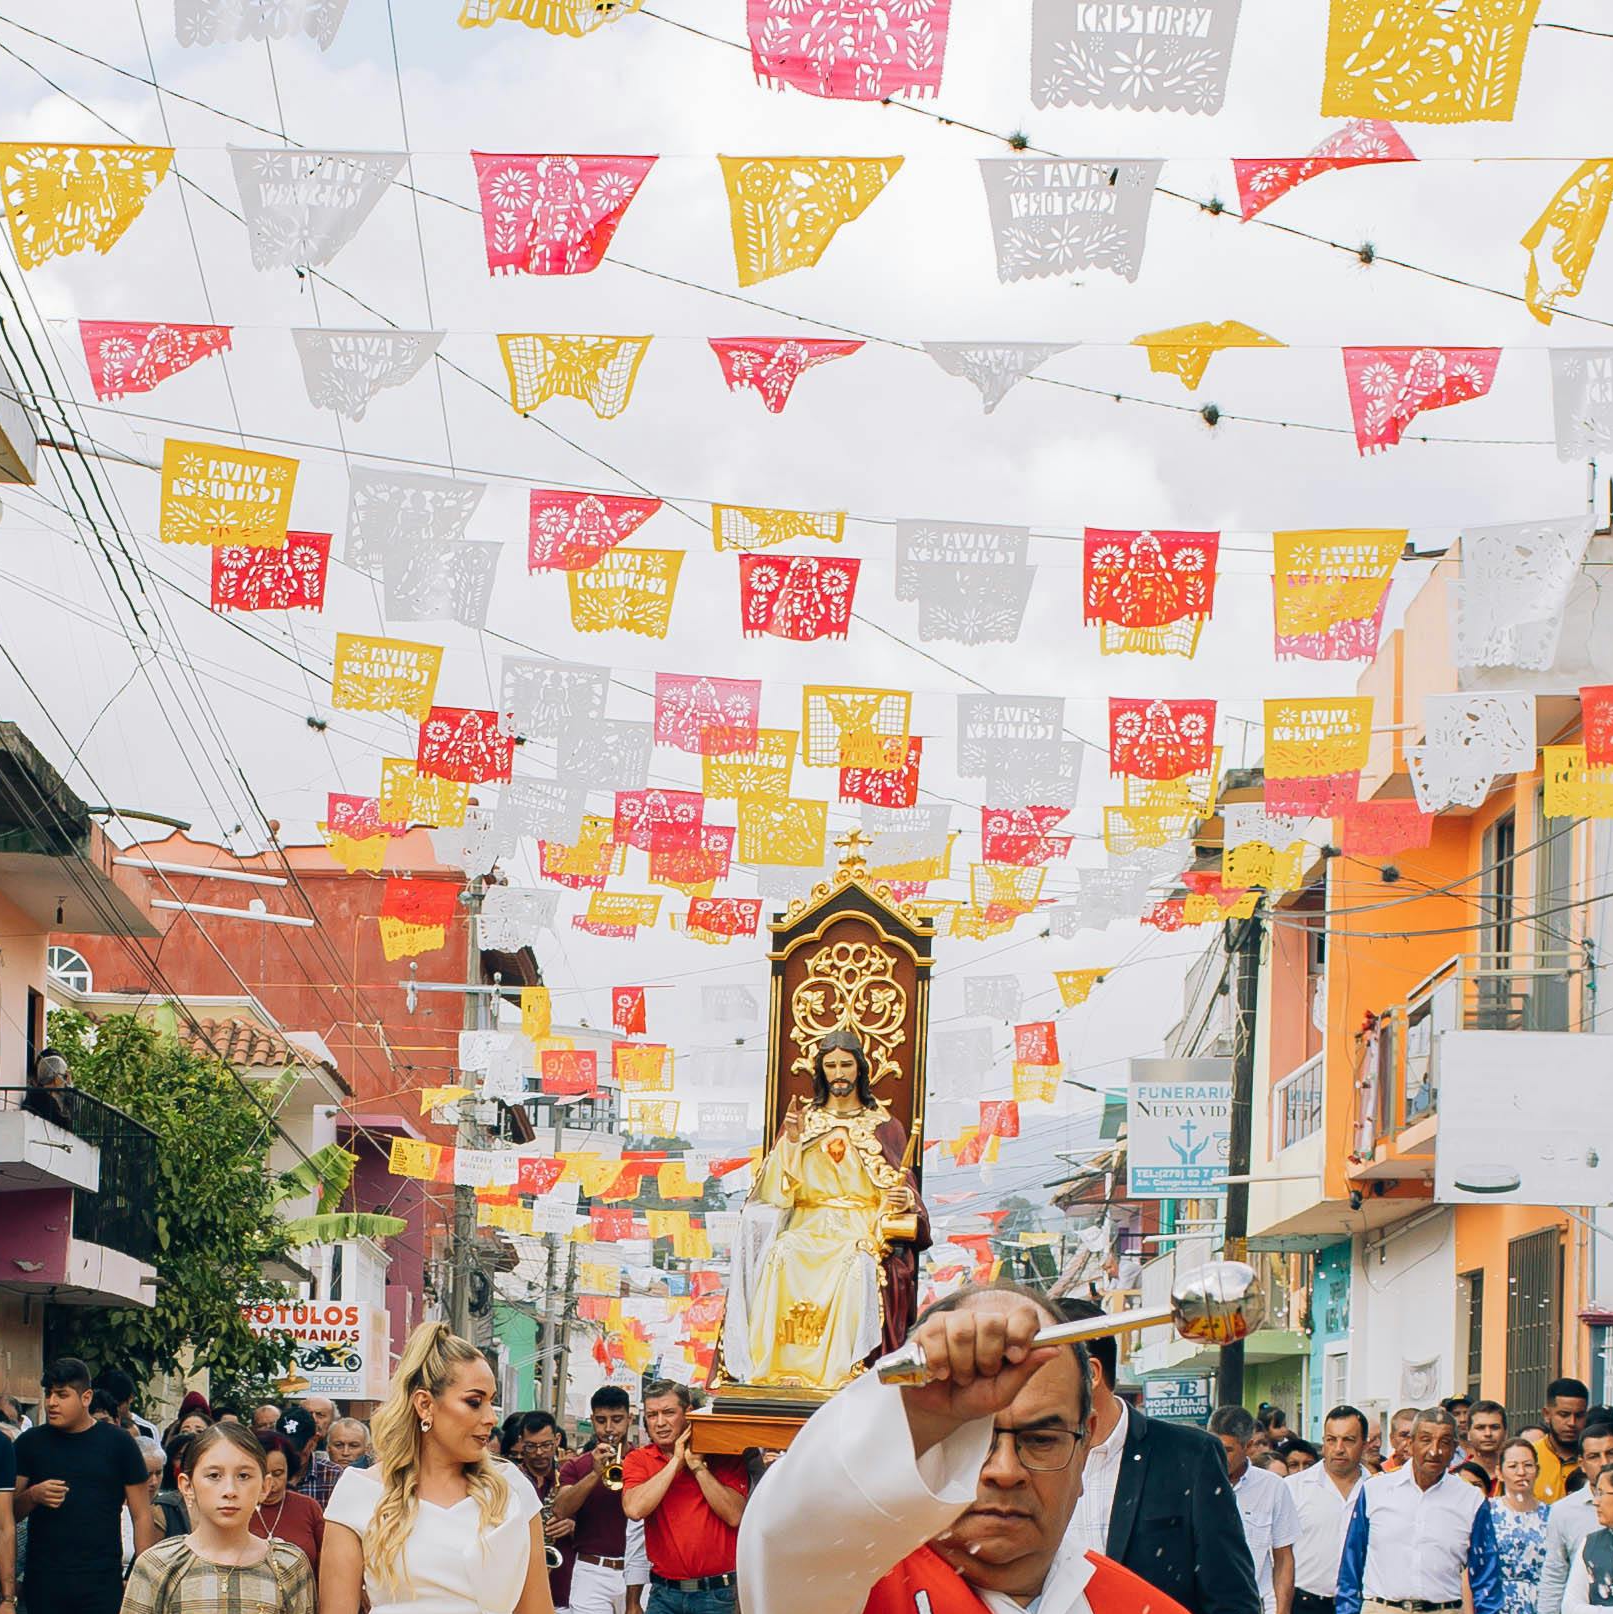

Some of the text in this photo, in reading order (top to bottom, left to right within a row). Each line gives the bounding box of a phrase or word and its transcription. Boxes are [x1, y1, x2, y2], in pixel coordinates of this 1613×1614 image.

[1138, 1087, 1233, 1099] FUNERARIA
[1137, 1101, 1227, 1117] NUEVA VID
[1146, 1397, 1208, 1408] HOSPEDAJE
[1147, 1406, 1207, 1417] EXCLUSIVO
